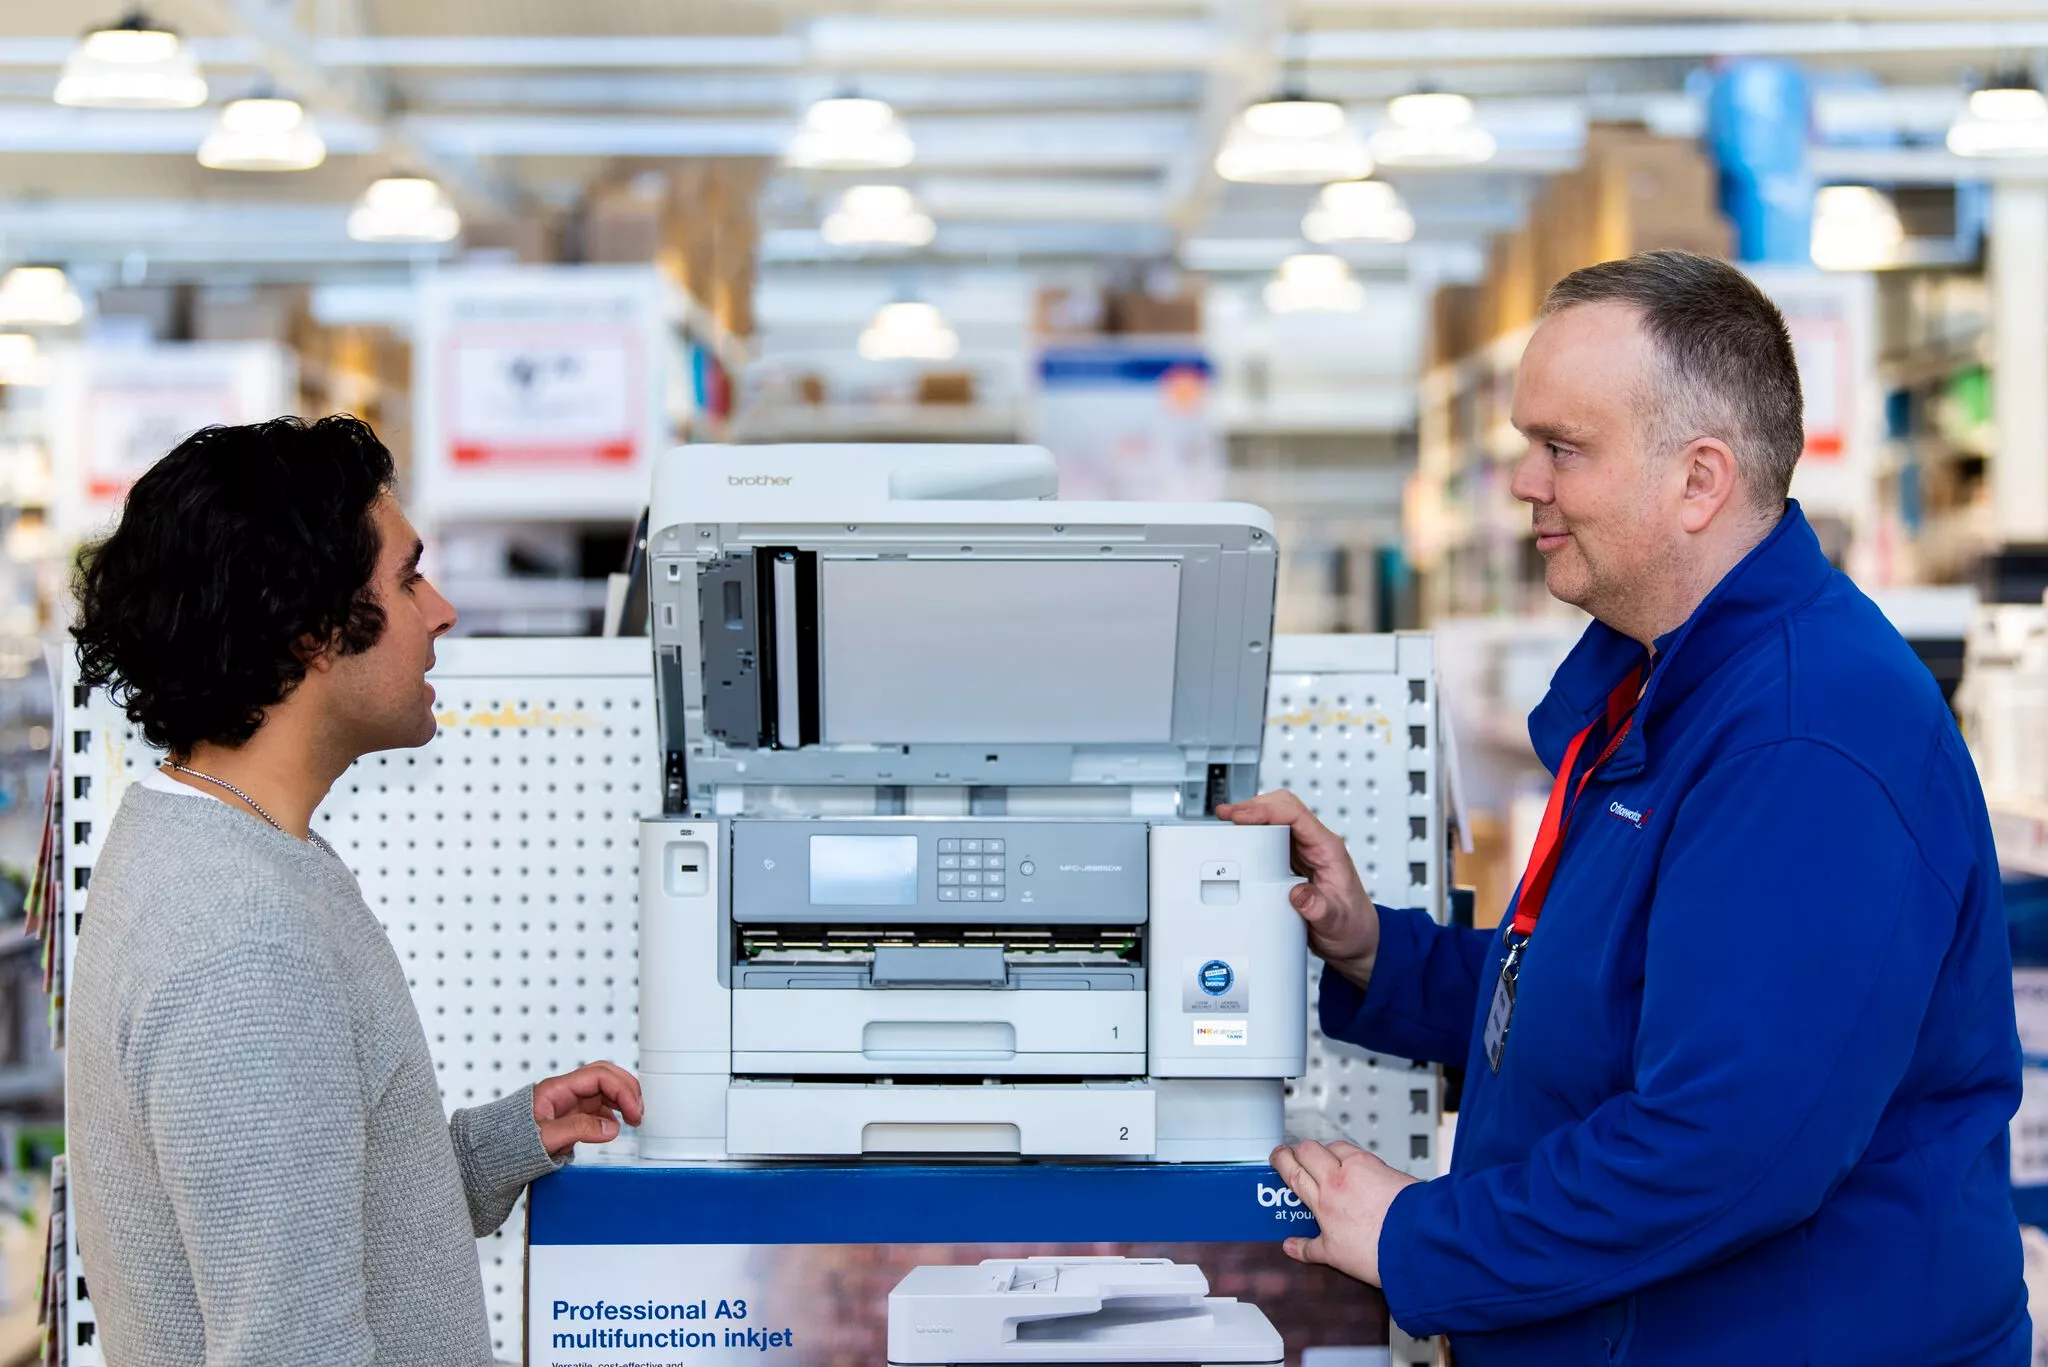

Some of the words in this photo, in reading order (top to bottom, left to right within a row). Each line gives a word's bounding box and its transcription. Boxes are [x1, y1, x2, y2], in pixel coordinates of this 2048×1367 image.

[727, 475, 793, 486] brother
[968, 842, 976, 850] 2
[1111, 1026, 1118, 1039] 1
[1119, 1126, 1129, 1141] 2
[1275, 1209, 1287, 1220] at
[1289, 1211, 1315, 1223] you
[553, 1300, 707, 1321] Professional
[714, 1299, 748, 1320] A3
[553, 1328, 716, 1349] multifunction
[724, 1327, 793, 1352] inkjet
